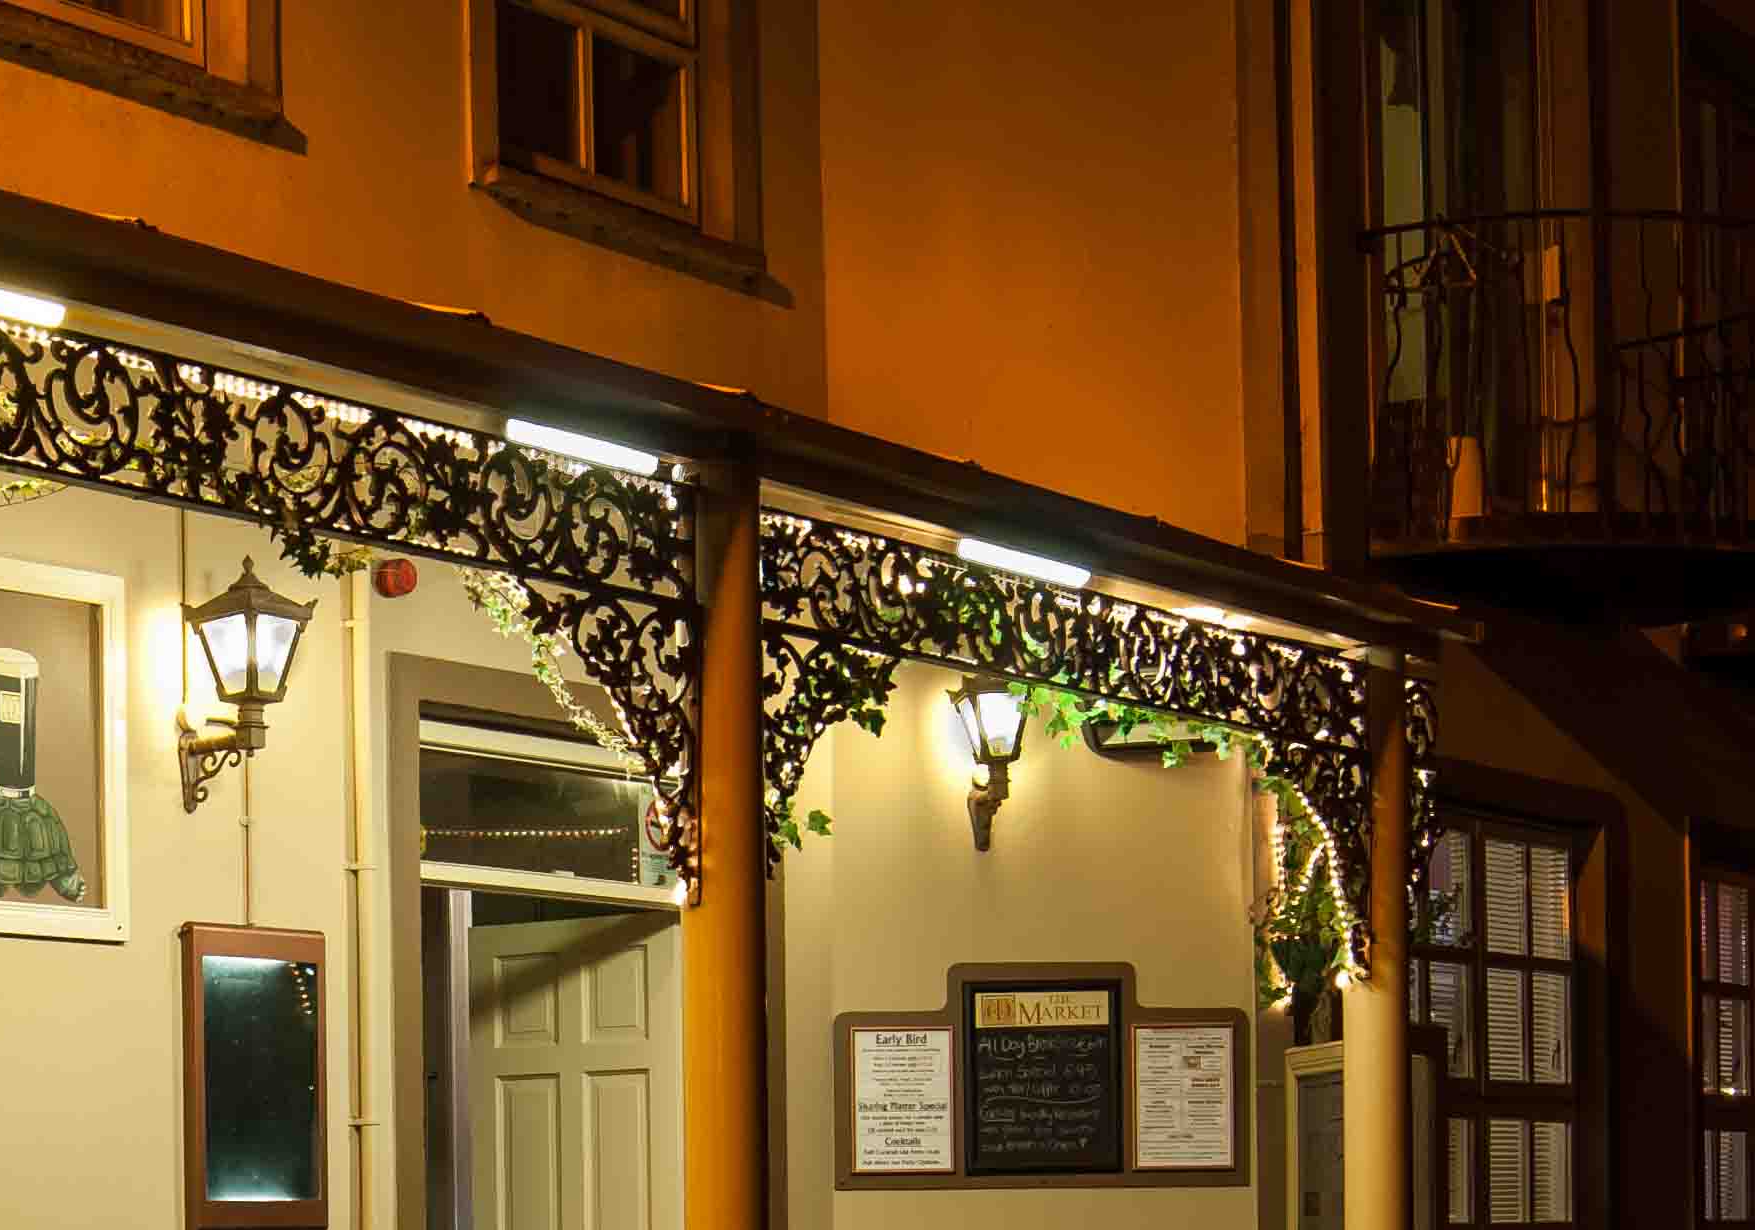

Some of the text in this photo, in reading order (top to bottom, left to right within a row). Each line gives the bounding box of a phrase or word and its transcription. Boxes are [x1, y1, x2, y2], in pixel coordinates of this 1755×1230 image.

[1019, 1002, 1101, 1024] MARKET
[875, 1033, 928, 1046] Early Bird
[884, 1136, 922, 1146] Cocktails
